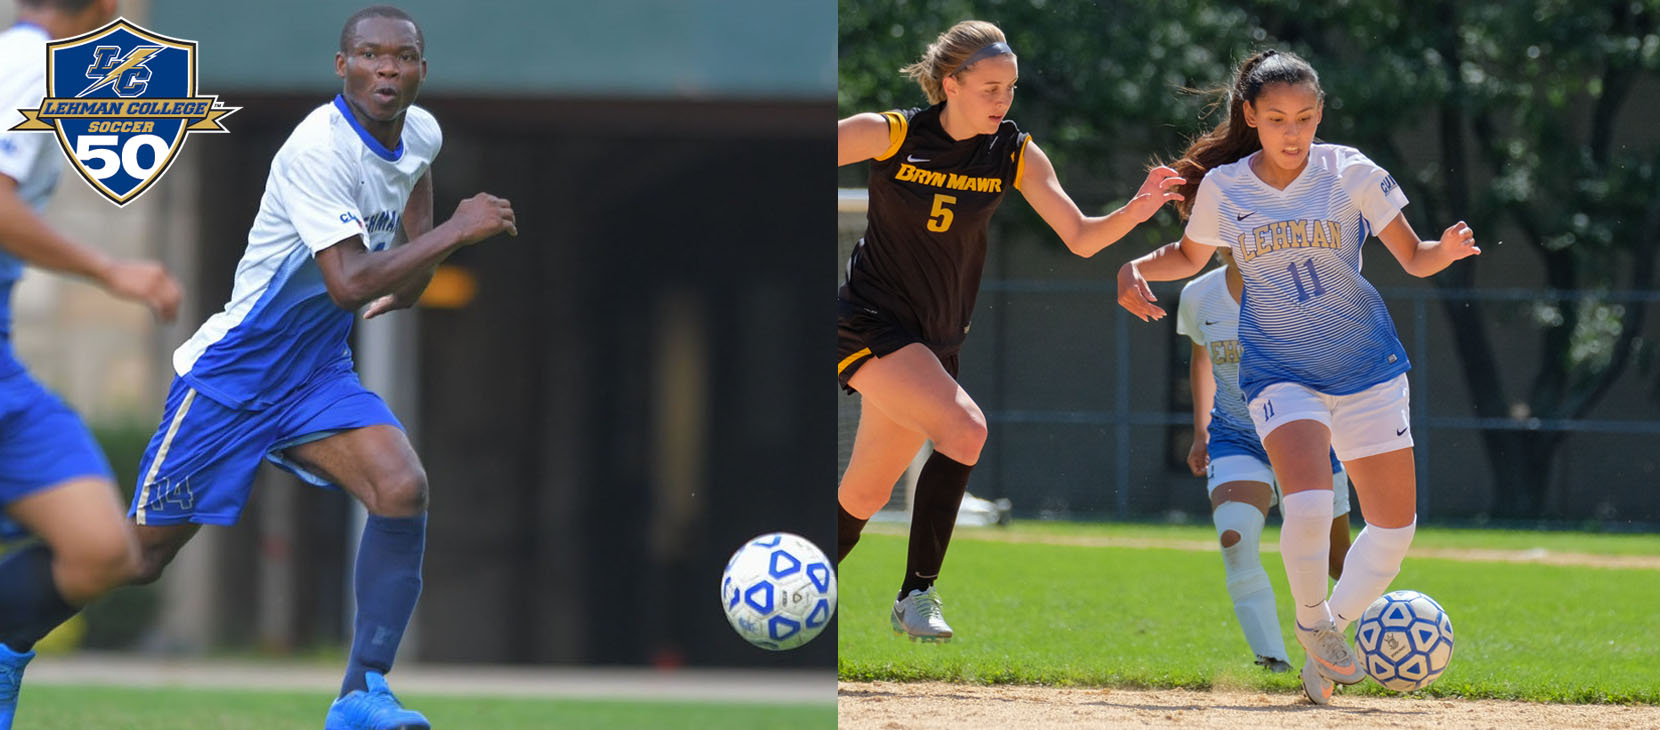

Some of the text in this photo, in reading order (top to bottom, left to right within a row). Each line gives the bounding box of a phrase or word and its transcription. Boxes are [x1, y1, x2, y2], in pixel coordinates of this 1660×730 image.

[926, 193, 957, 233] 5
[1238, 219, 1342, 263] LEHMAN
[1287, 258, 1325, 302] 11
[1263, 400, 1275, 422] 11
